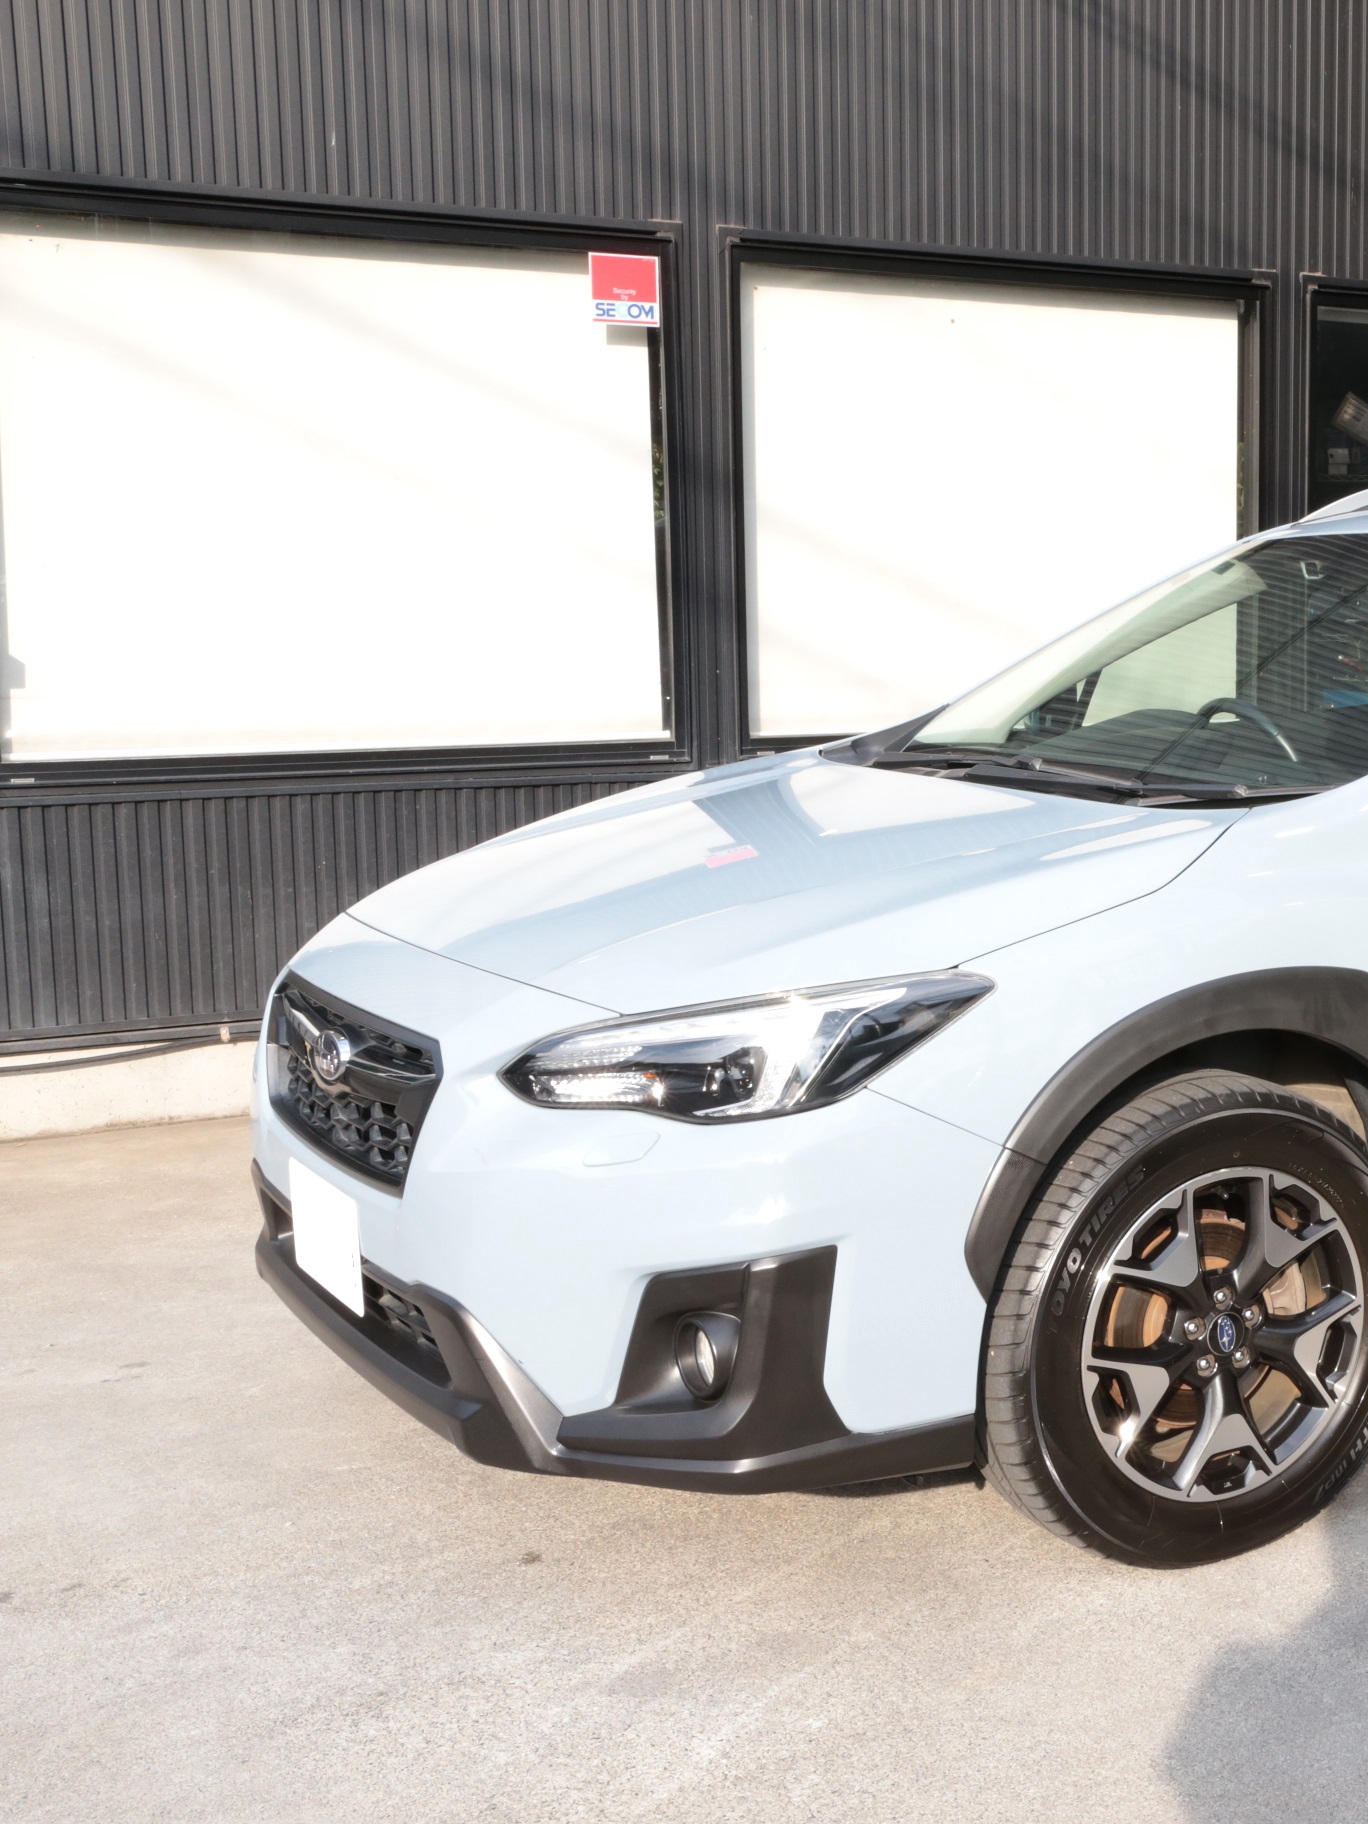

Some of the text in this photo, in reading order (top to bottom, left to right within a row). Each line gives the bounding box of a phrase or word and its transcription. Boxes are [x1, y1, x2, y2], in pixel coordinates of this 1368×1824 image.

[612, 287, 636, 296] Security
[595, 302, 655, 319] SECOM
[1079, 1164, 1145, 1247] TIRES
